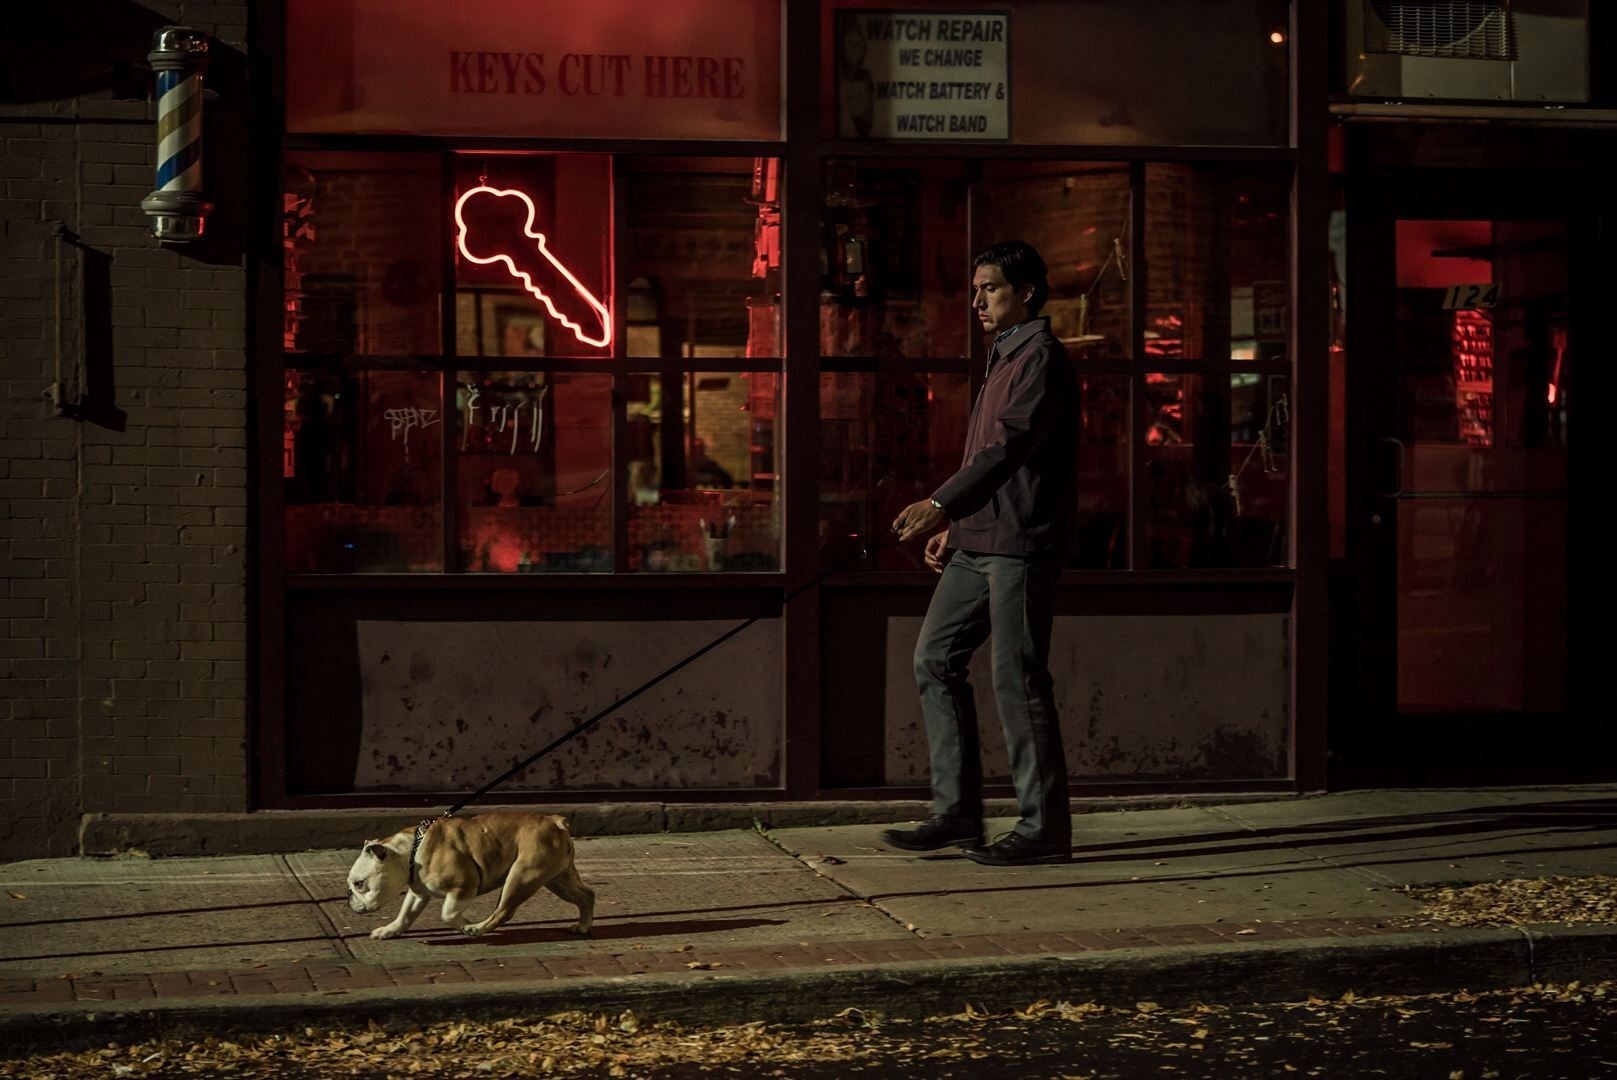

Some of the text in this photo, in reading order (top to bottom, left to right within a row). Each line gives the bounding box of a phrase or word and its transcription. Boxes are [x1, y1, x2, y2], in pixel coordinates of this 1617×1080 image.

[866, 19, 1004, 42] WATCH REPAIR
[899, 49, 983, 67] WE CHANGE
[448, 51, 745, 99] KEYS CUT HERE
[876, 82, 1005, 100] WATCH BATTERY &
[896, 115, 988, 133] WATCH BAND
[1451, 284, 1499, 307] 124
